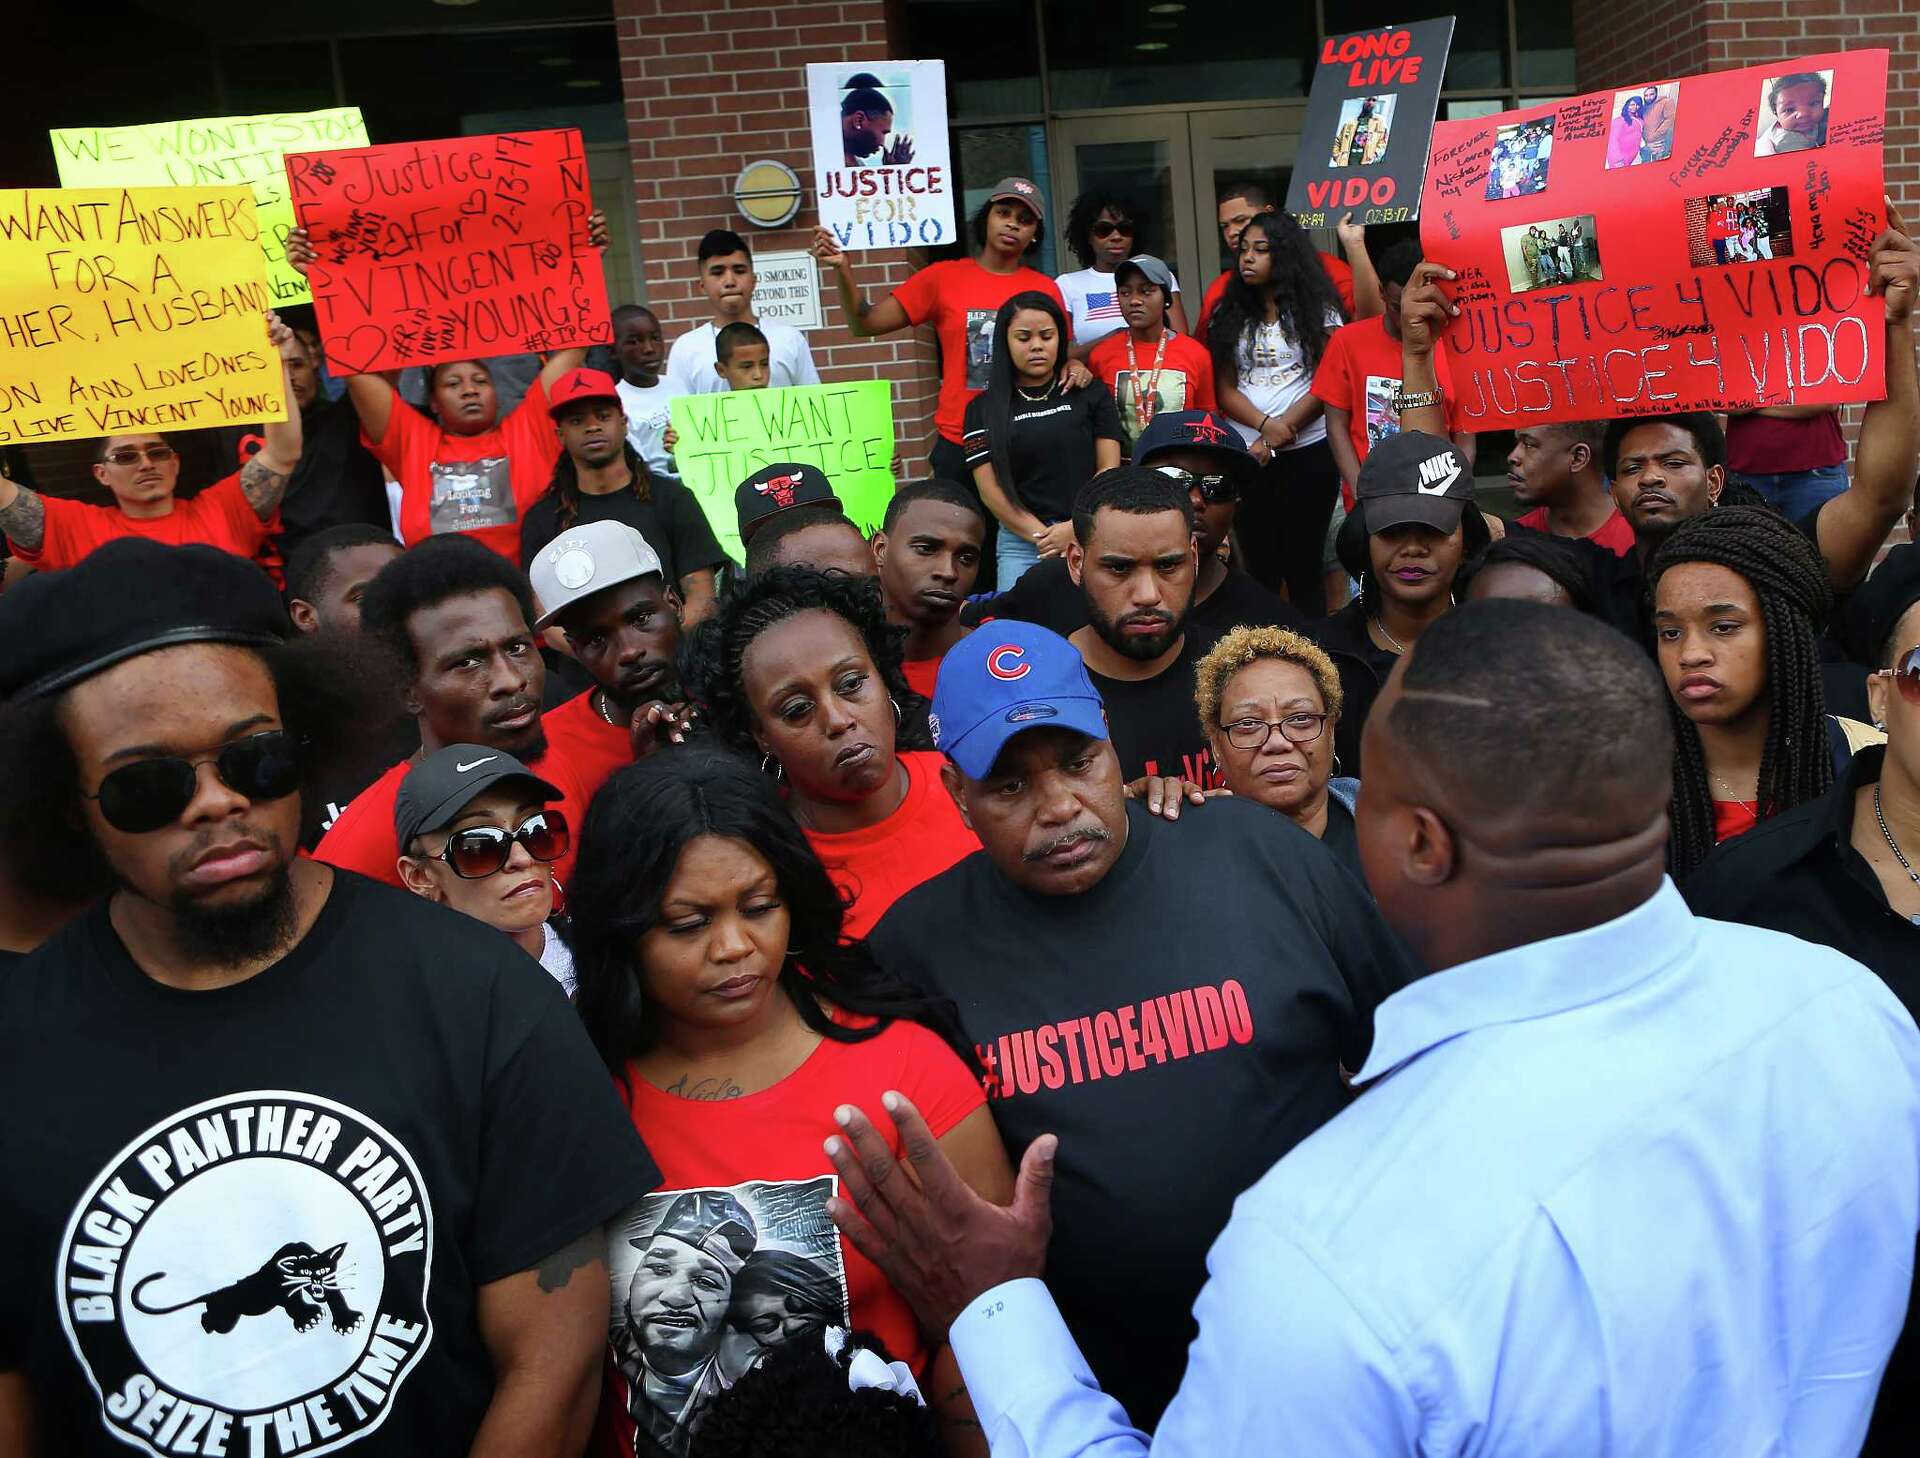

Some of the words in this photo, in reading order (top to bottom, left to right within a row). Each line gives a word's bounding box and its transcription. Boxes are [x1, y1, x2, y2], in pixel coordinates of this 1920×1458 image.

[1320, 30, 1411, 65] LONG
[1348, 56, 1423, 88] LIVE
[58, 130, 134, 162] WE
[271, 116, 363, 143] STOP
[820, 166, 944, 198] JUSTICE
[1307, 175, 1396, 209] VIDO
[0, 190, 110, 242] WANT
[117, 189, 259, 246] ANSWERS
[855, 196, 917, 225] FOR
[832, 217, 943, 248] VIDO
[47, 250, 140, 293] FOR
[152, 254, 182, 294] A
[764, 267, 807, 282] SMOKING
[103, 282, 268, 338] HUSBAND
[788, 286, 809, 299] THIS
[1453, 285, 1660, 360] JUSTICE
[1677, 277, 1710, 328] 4
[1724, 258, 1859, 317] VIDO
[450, 287, 571, 349] YOUNG
[758, 303, 806, 318] POINT
[1464, 343, 1679, 417] JUSTICE
[1687, 336, 1725, 393] 4
[1740, 316, 1868, 403] VIDO
[69, 375, 133, 405] AND
[13, 414, 77, 438] LIVE
[86, 401, 203, 432] VINCENT
[205, 388, 280, 419] YOUNG
[686, 396, 749, 443] WE
[752, 389, 859, 443] WANT
[1418, 450, 1457, 485] NIKE
[459, 503, 480, 514] For
[987, 645, 1032, 681] C
[70, 1176, 156, 1322] BLACK
[137, 1105, 342, 1192] PANTHER
[336, 1136, 425, 1258] PARTY
[105, 1372, 234, 1458] SEIZE
[241, 1393, 343, 1458] THE
[333, 1312, 424, 1422] TIME
